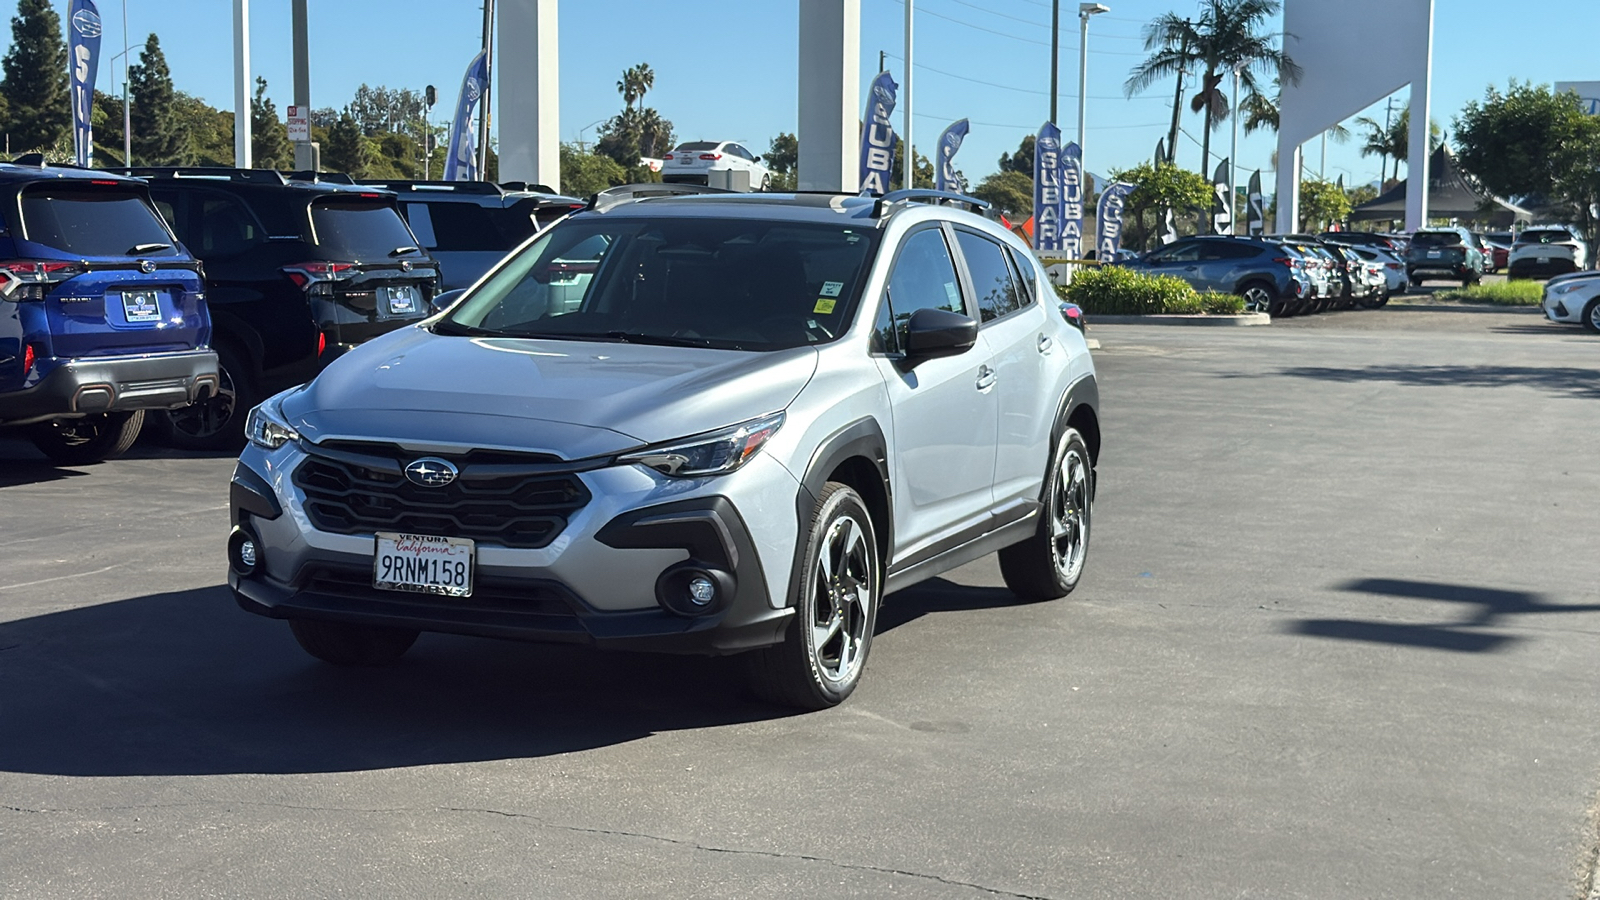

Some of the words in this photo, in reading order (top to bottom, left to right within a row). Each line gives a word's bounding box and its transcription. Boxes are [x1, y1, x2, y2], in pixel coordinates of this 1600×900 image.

[399, 534, 449, 543] VENTURA
[396, 539, 455, 556] California
[381, 555, 465, 586] 9RNM158
